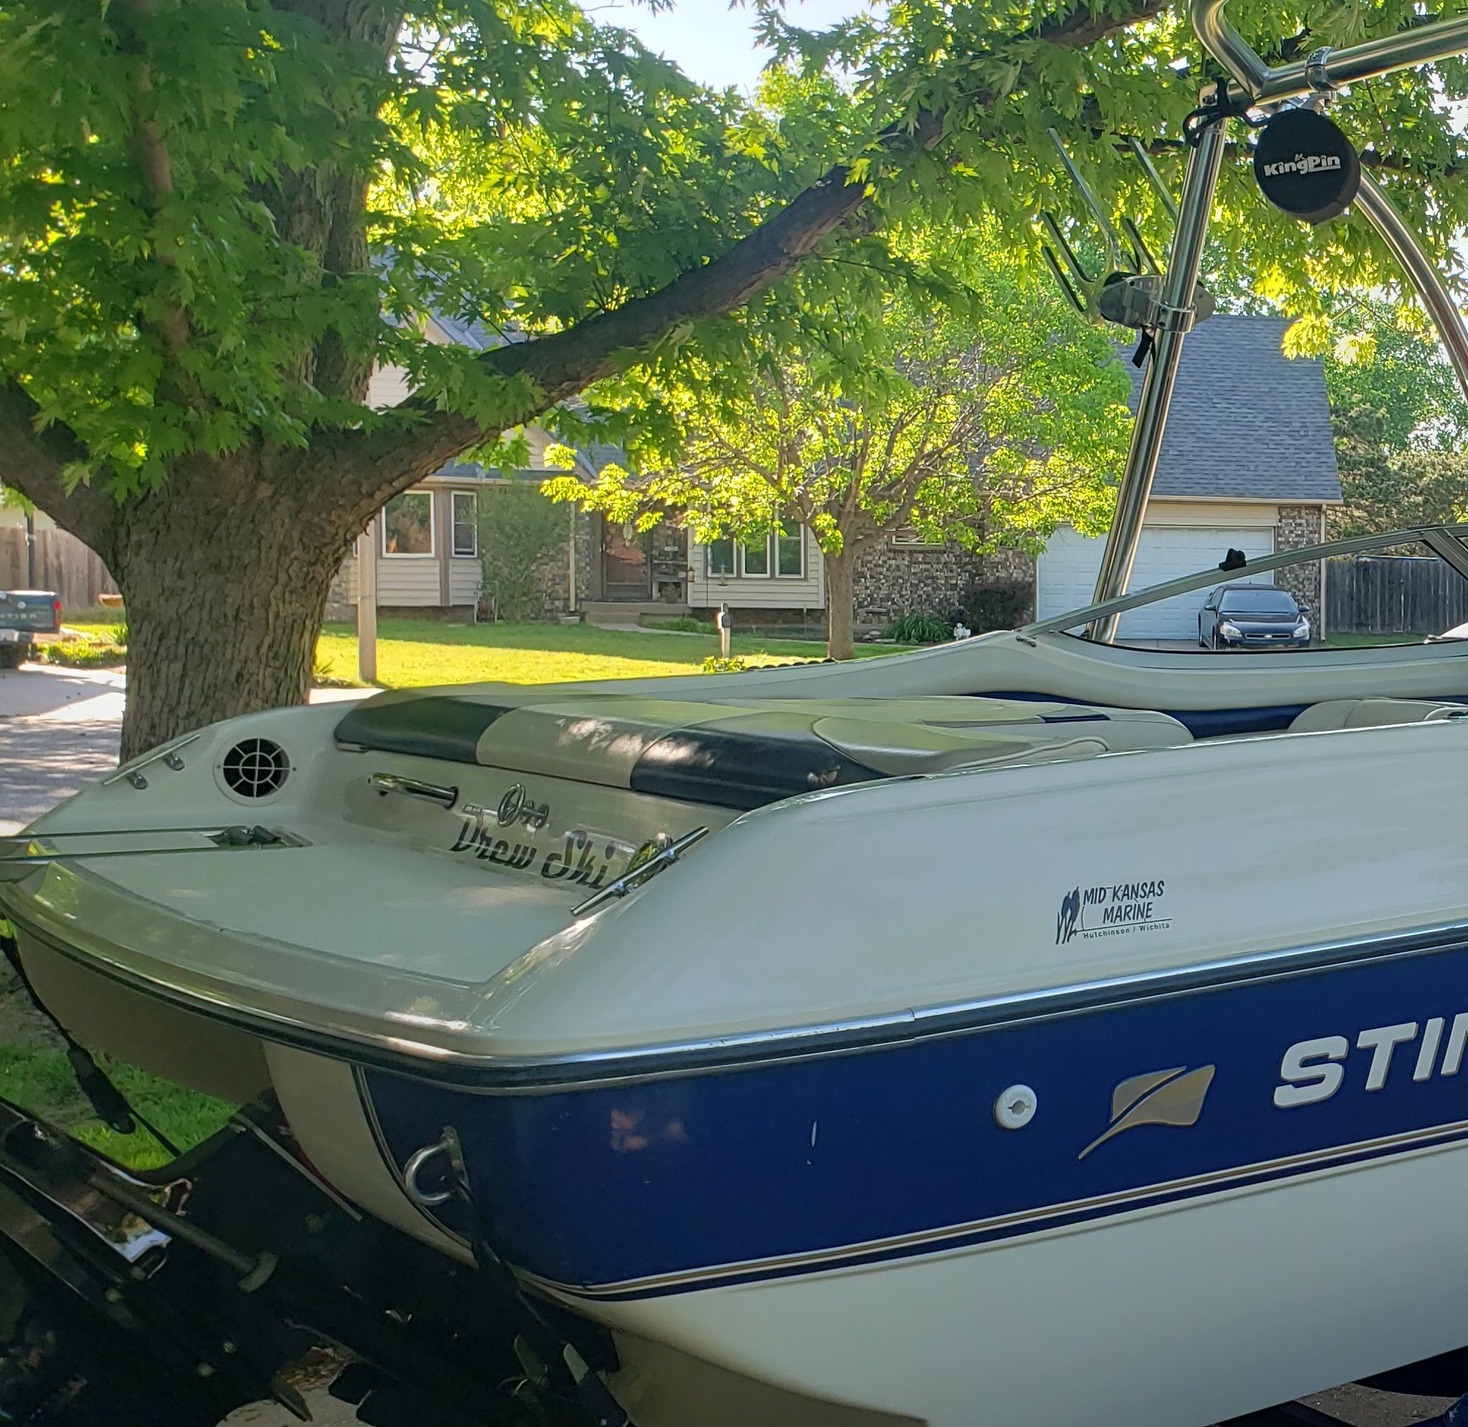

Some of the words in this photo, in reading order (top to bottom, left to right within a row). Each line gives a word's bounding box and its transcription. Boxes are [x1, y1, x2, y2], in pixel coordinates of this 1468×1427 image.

[1263, 154, 1341, 177] KingPin
[450, 804, 537, 870] Drew
[1083, 886, 1107, 906] MID
[1112, 880, 1165, 902] KANSAS
[1103, 901, 1154, 924] MARINE
[1083, 927, 1130, 939] Hutchinson
[1139, 922, 1171, 932] Wichita
